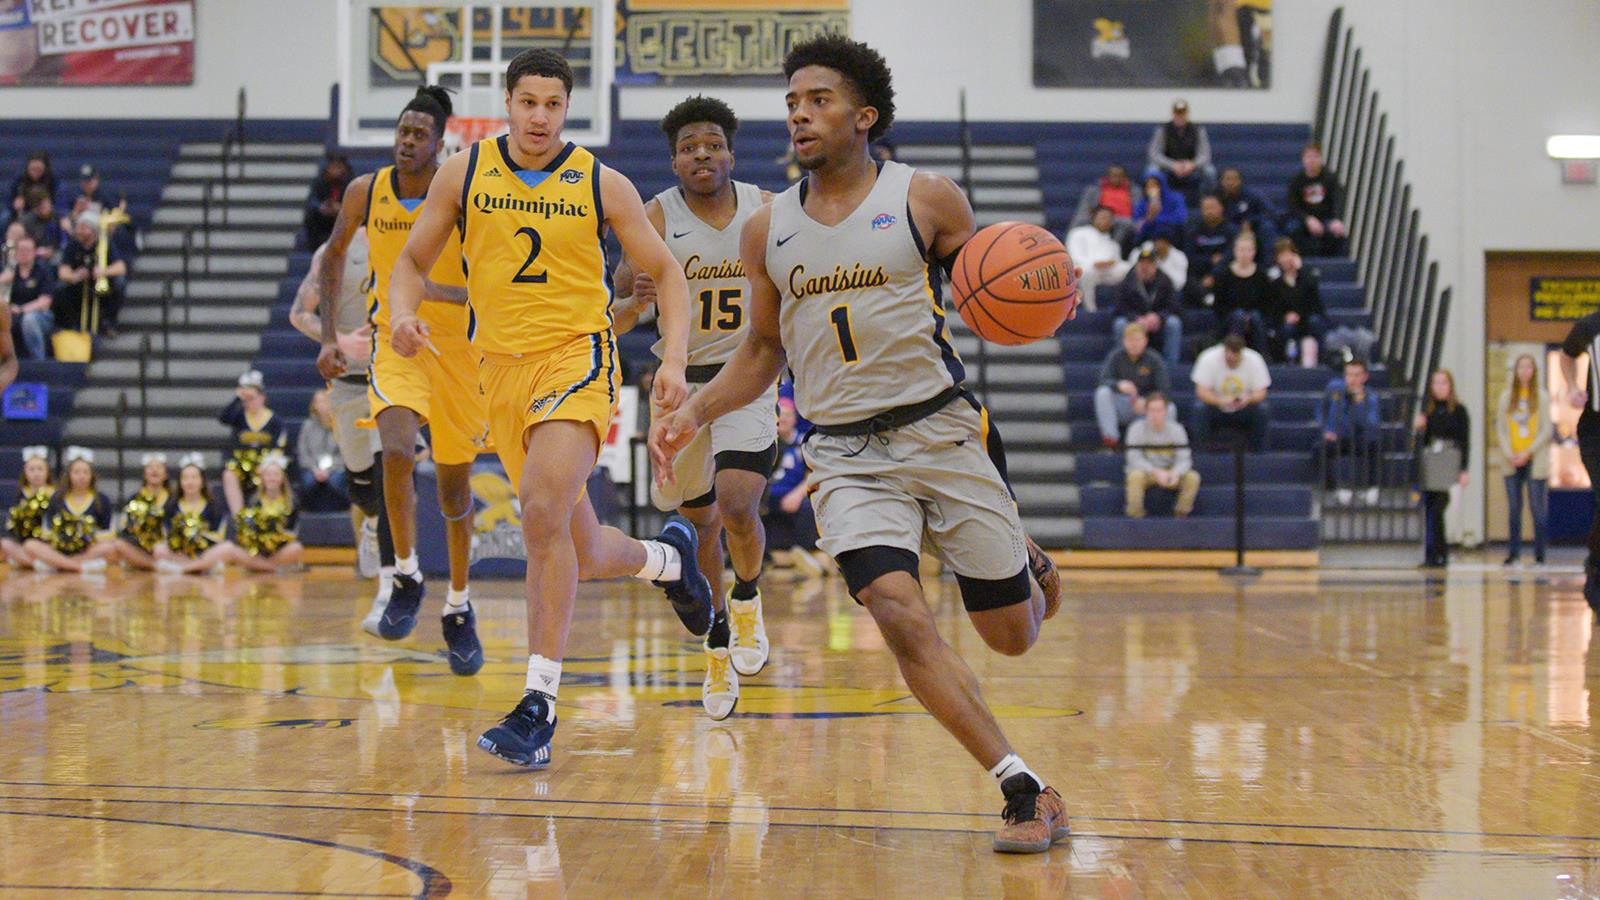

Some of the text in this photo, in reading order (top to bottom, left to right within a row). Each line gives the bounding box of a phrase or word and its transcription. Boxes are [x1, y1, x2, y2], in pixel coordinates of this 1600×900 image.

[473, 192, 588, 219] Quinnipiac
[512, 226, 548, 283] 2
[789, 262, 889, 299] Canisius
[1019, 263, 1060, 291] ROCK
[698, 286, 743, 333] 15
[829, 303, 860, 366] 1
